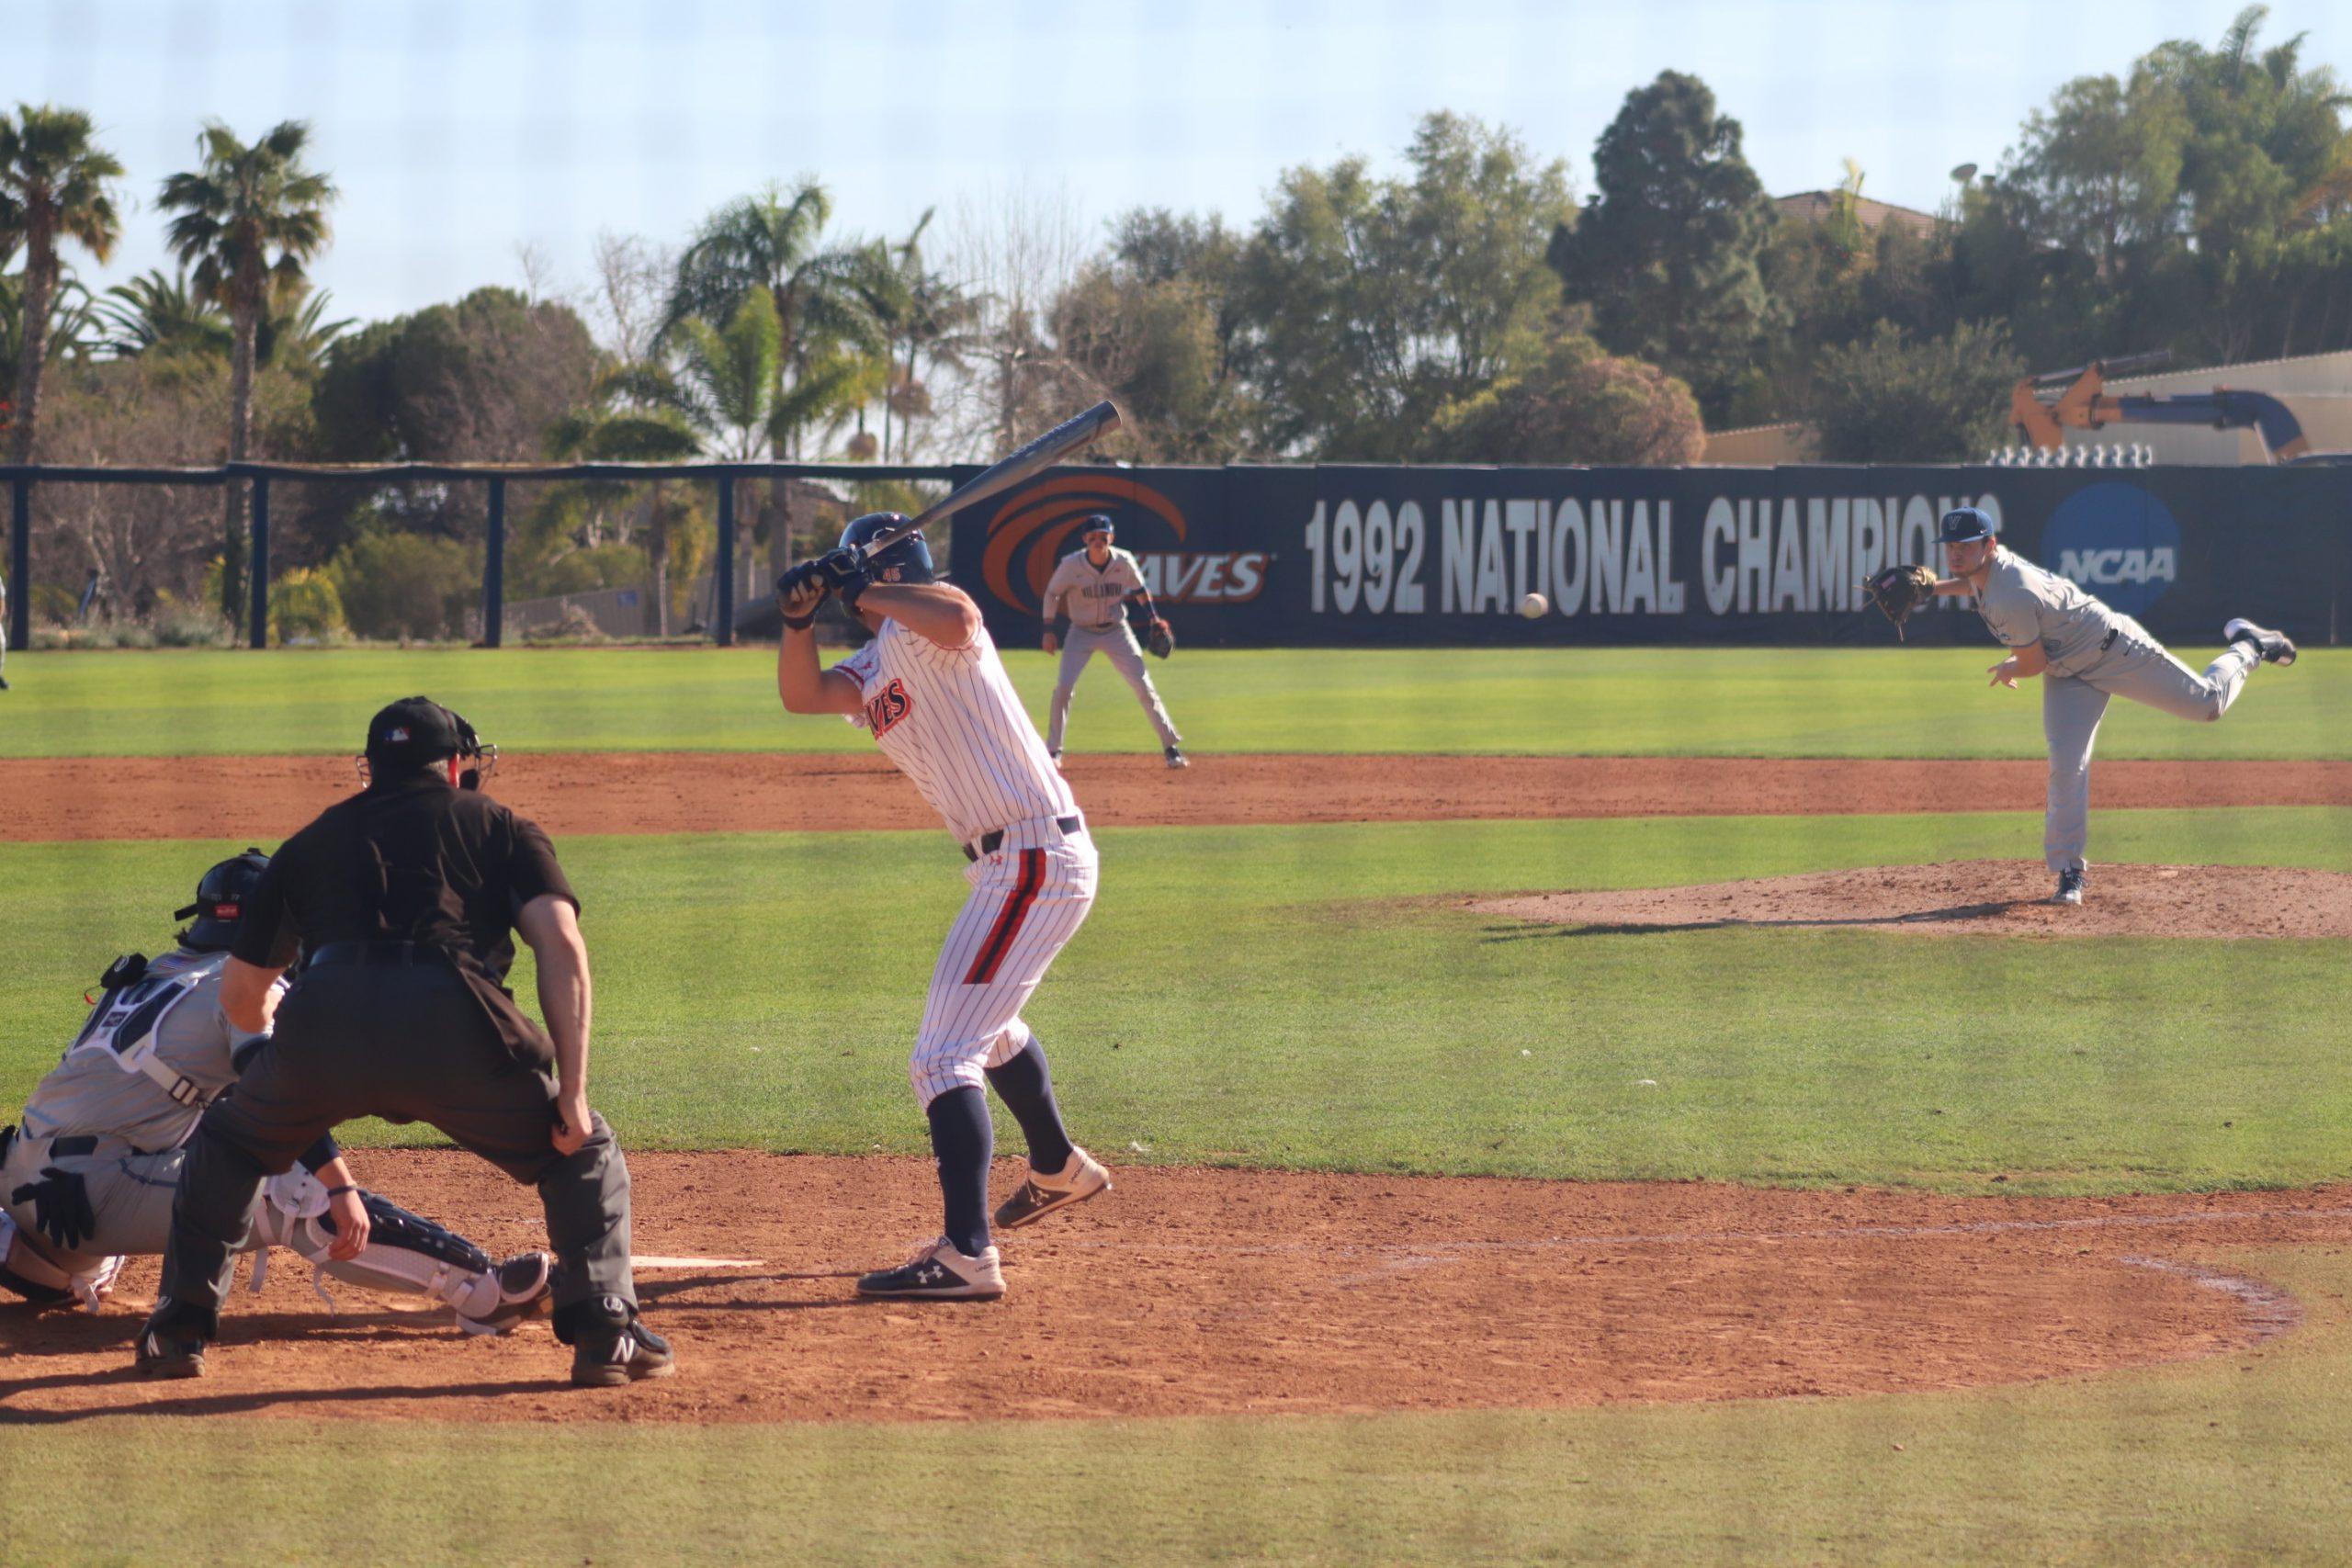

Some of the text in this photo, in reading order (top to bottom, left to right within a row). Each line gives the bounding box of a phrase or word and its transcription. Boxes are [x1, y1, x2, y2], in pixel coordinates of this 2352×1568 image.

[1125, 552, 1264, 597] AVES
[1305, 499, 1425, 615] 1992
[1441, 497, 1685, 616] NATIONAL
[2059, 548, 2176, 584] NCAA
